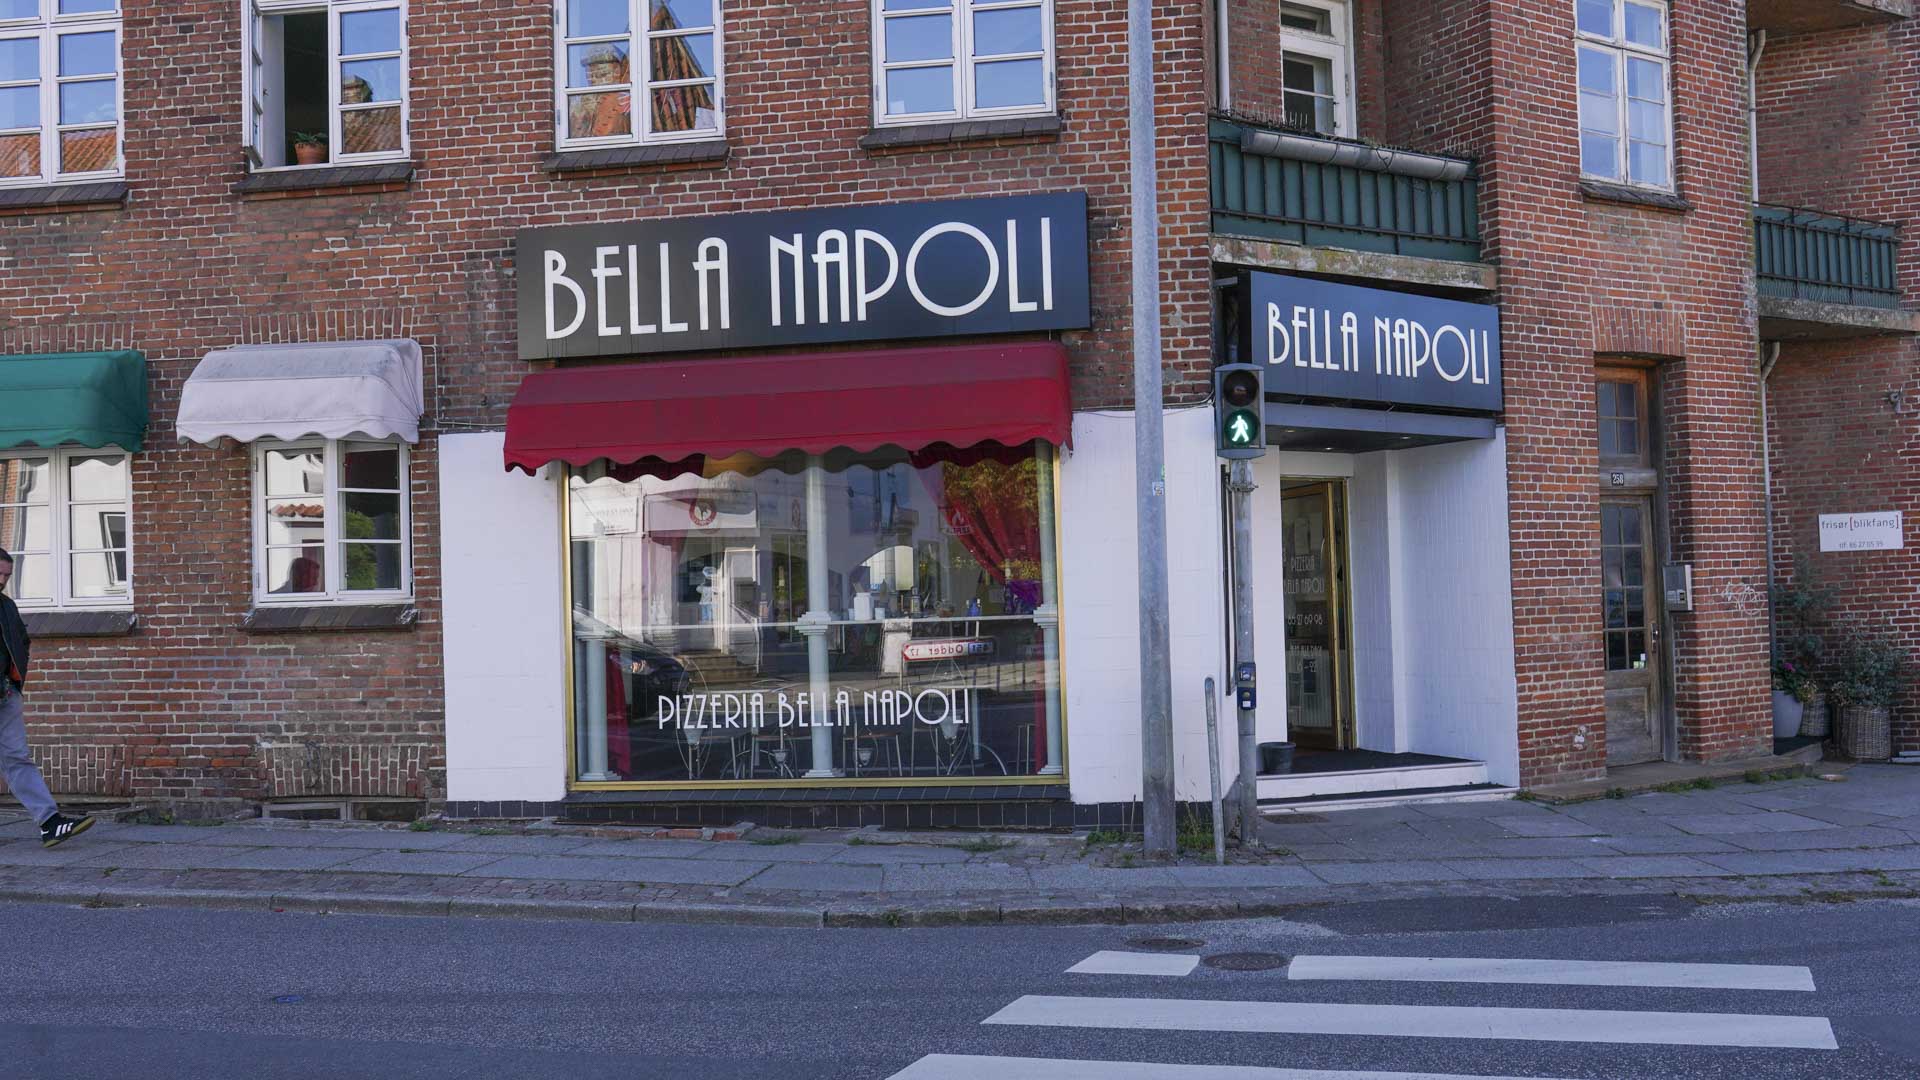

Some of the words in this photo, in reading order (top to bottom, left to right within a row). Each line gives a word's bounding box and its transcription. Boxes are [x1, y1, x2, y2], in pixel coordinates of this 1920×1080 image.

[544, 236, 730, 340] BELLA
[769, 217, 1053, 327] NAPOLI
[1267, 302, 1359, 372] BELLA
[1374, 315, 1490, 385] NAPOLI
[1612, 473, 1624, 485] 258
[658, 693, 765, 729] PIZZERIA
[778, 691, 850, 727] BELLA
[863, 688, 969, 726] NAPOLI
